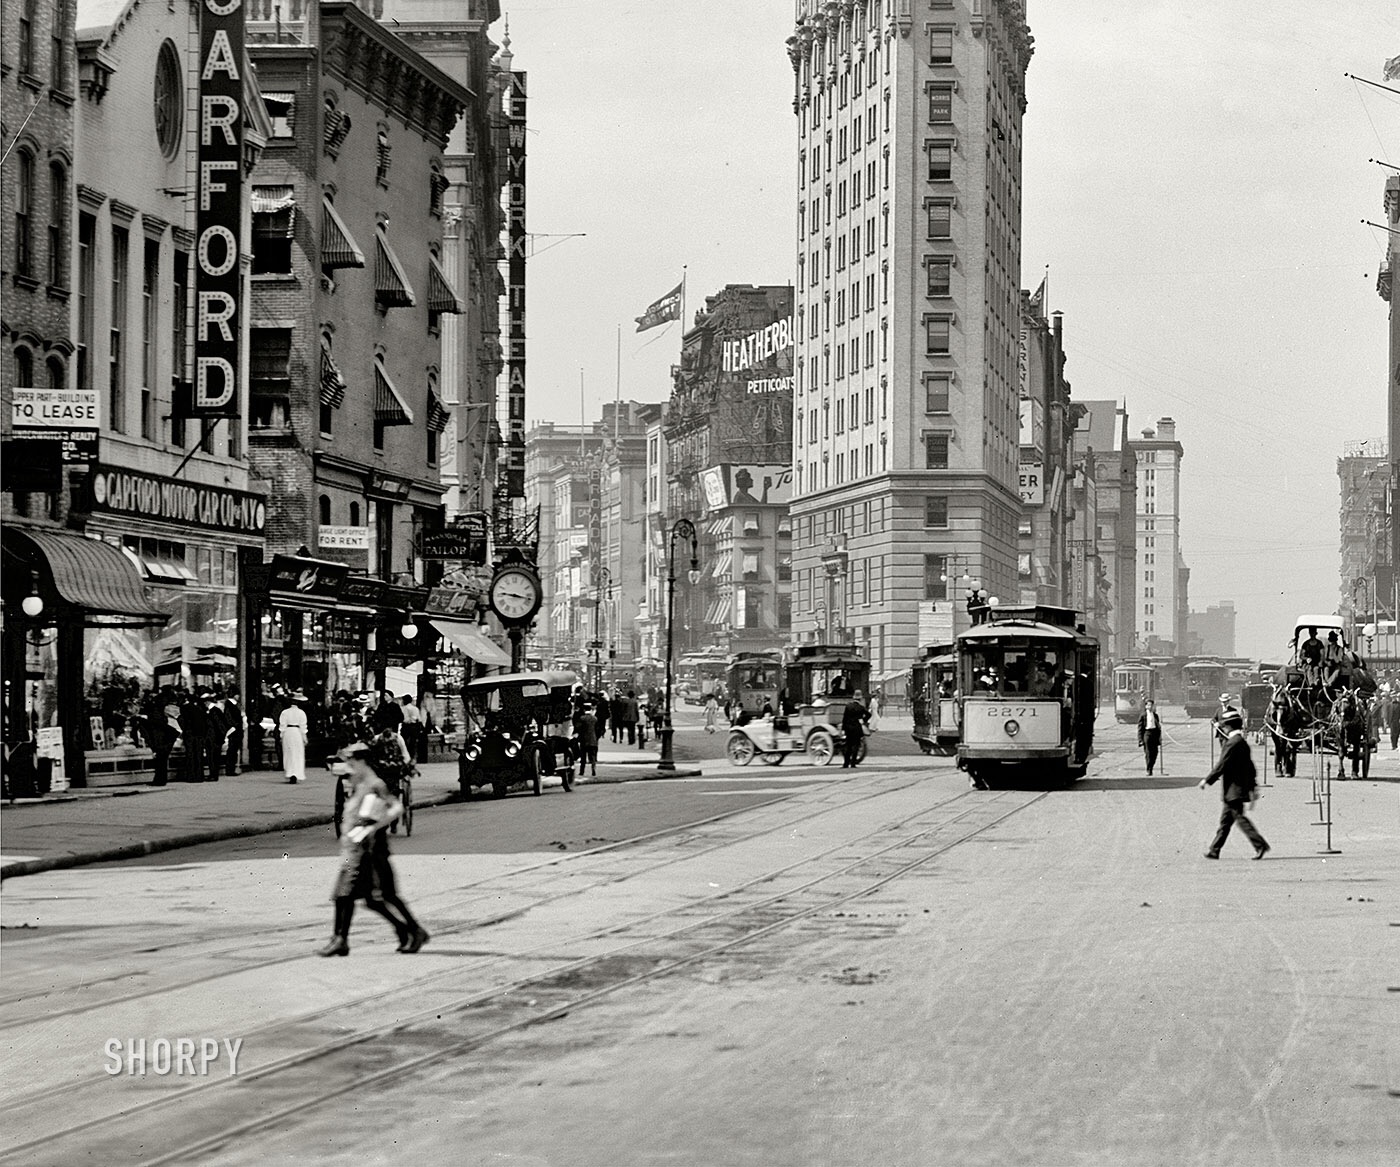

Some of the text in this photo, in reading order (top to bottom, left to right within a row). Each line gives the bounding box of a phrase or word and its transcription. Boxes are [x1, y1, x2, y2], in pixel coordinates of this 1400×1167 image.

[508, 71, 526, 472] NEW YORK THEATRE
[14, 404, 95, 419] TO LEASE
[106, 472, 161, 515] GARFORD
[161, 483, 198, 522] MOTOR
[199, 490, 220, 526] CAR
[590, 469, 600, 583] BROADWAY
[320, 536, 362, 545] FOR RENT
[424, 546, 467, 554] TAILOR
[987, 706, 1039, 717] 2271
